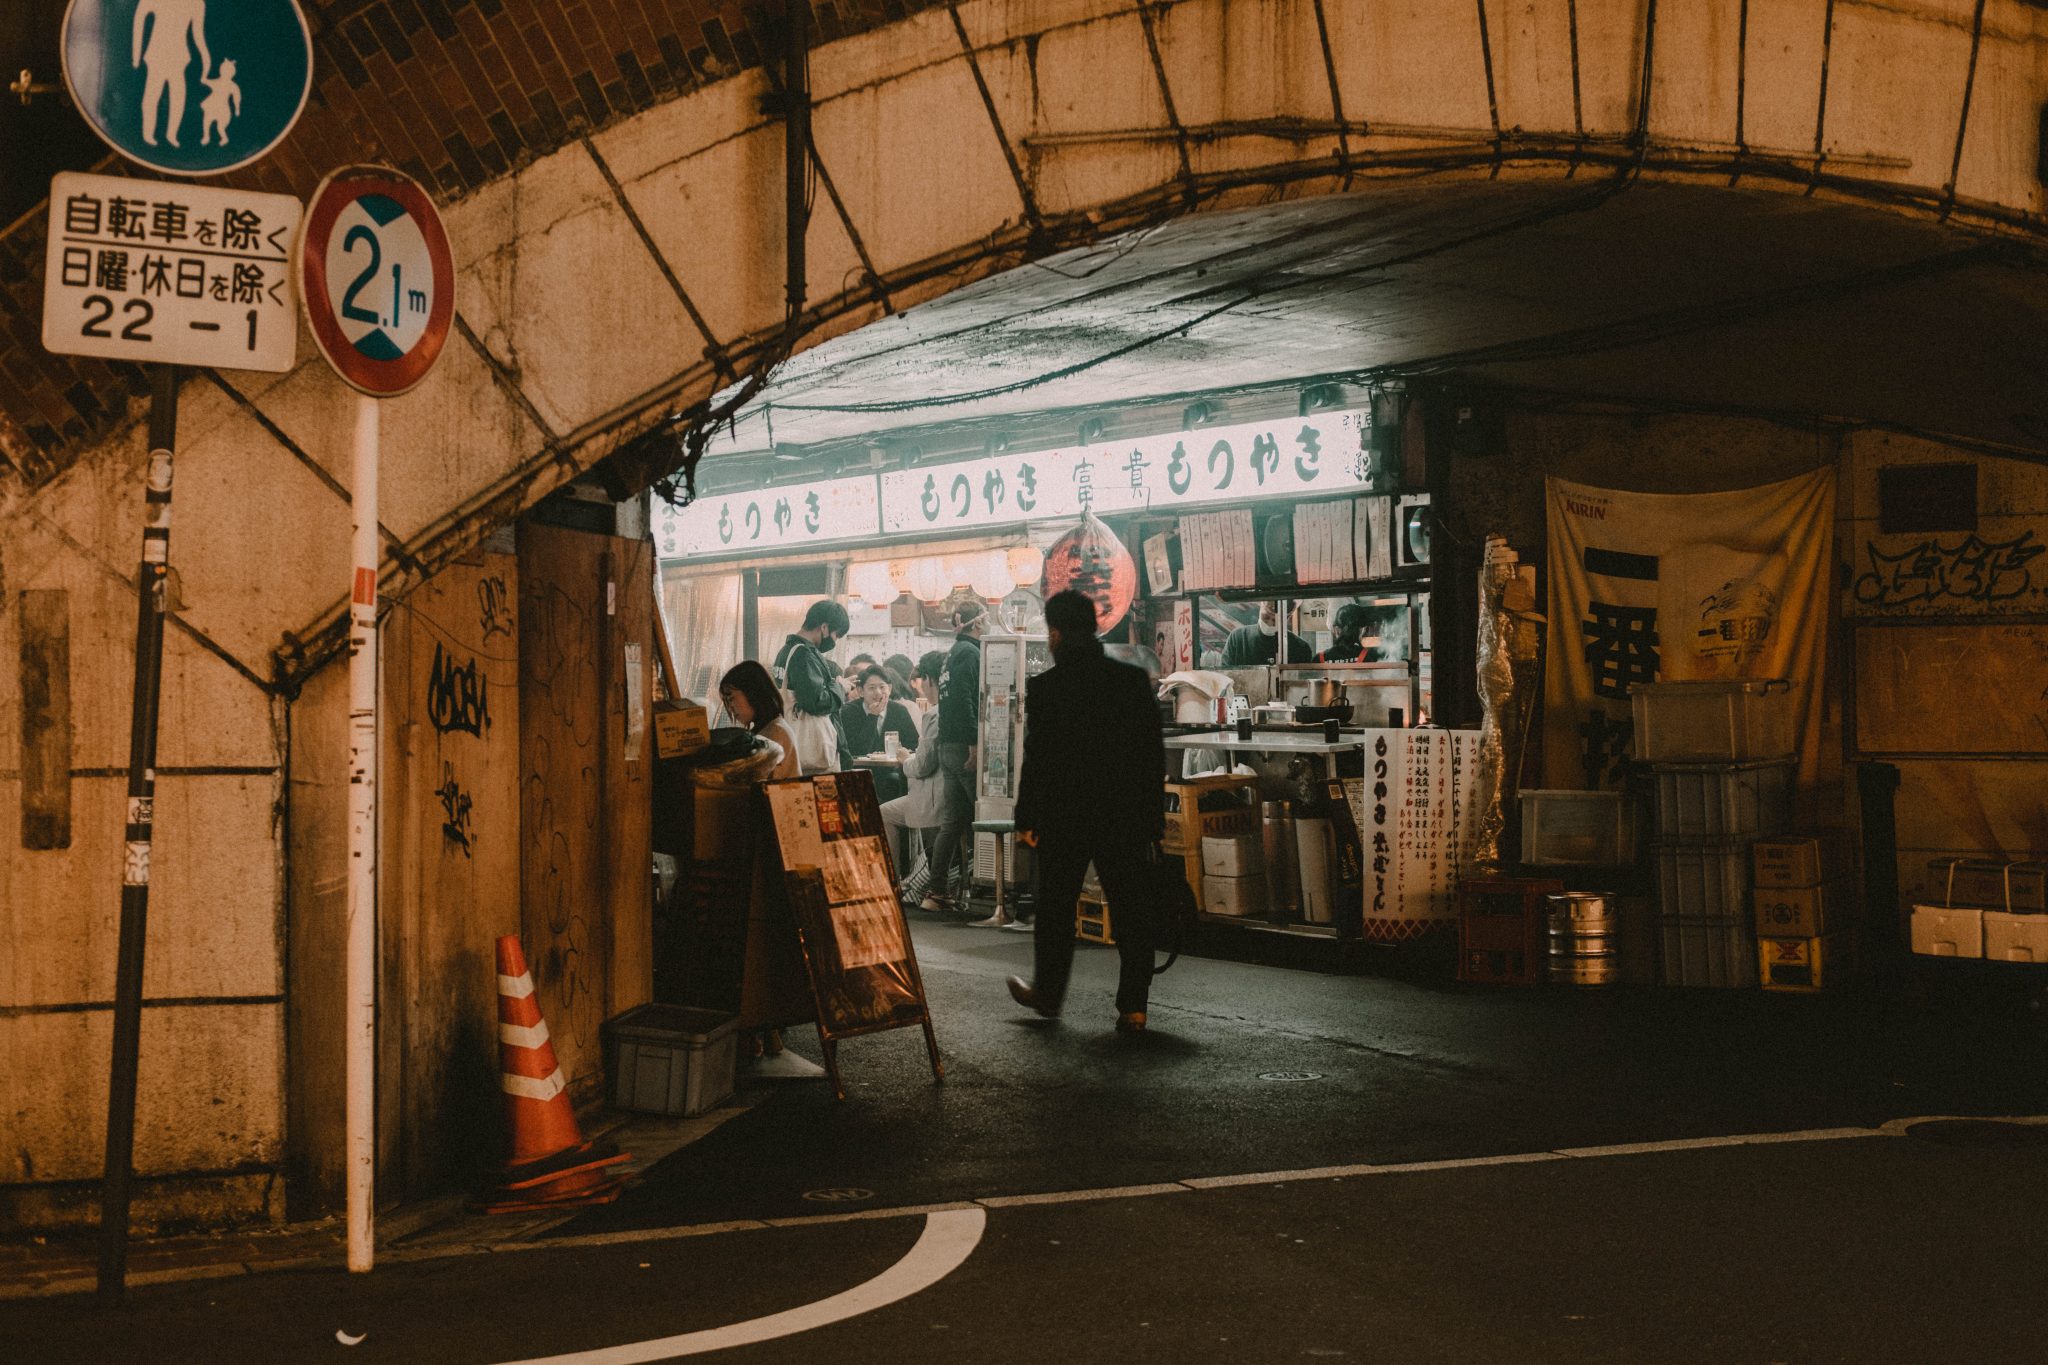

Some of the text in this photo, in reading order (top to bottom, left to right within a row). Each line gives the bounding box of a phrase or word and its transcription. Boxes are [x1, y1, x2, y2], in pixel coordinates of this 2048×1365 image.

[65, 193, 288, 254] 自転車を除く
[81, 295, 155, 343] 22
[246, 309, 259, 352] 1
[1566, 498, 1606, 521] KIRIN
